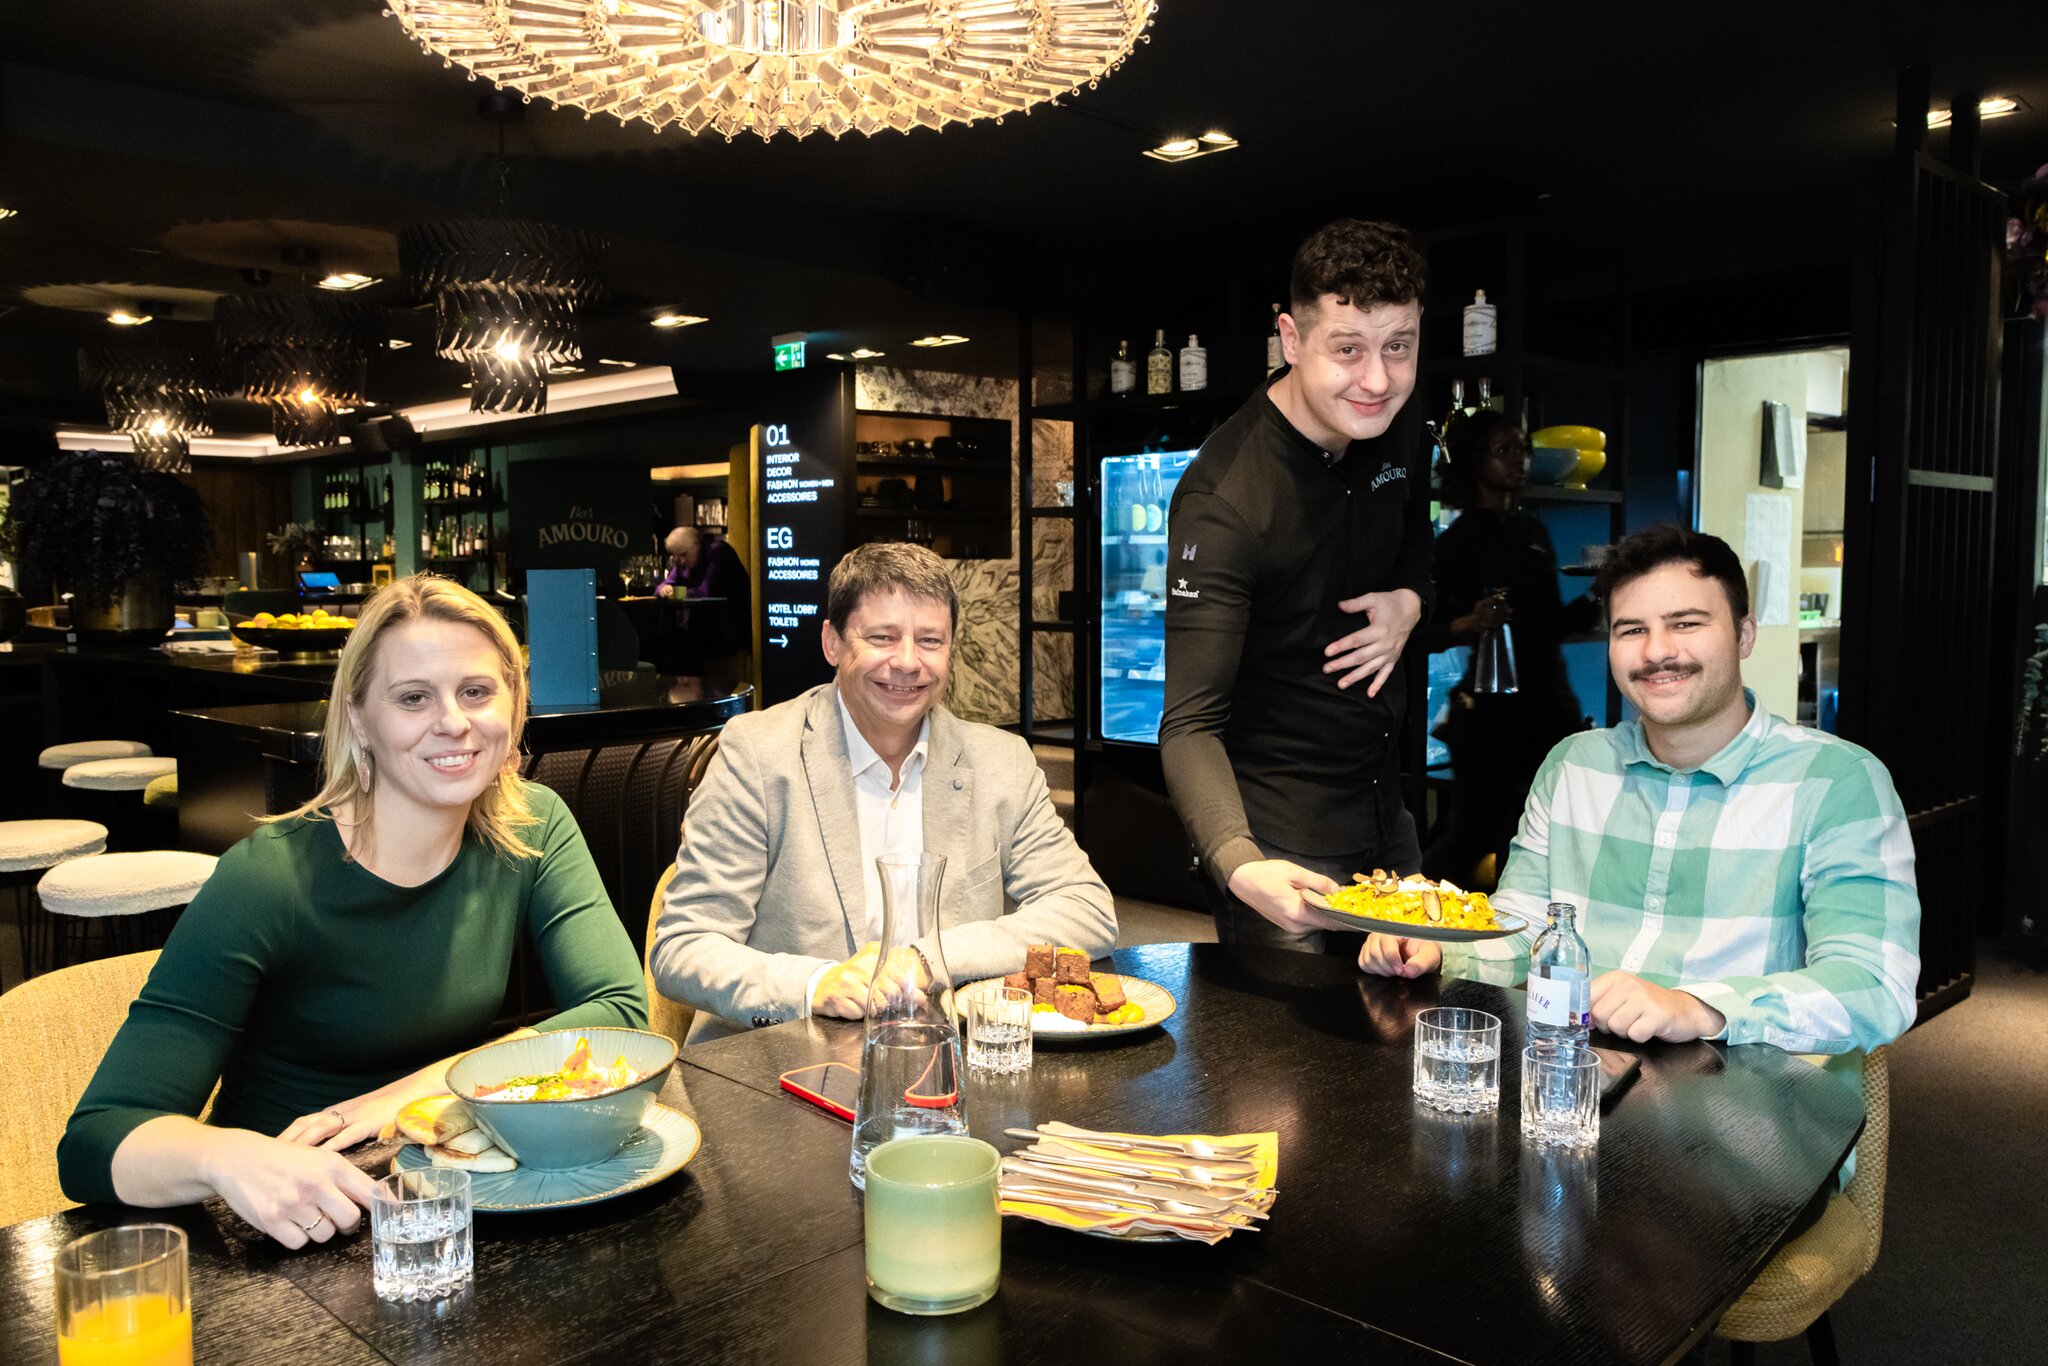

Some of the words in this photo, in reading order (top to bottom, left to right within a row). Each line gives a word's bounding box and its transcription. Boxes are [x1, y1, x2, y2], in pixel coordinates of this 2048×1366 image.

[766, 424, 790, 446] 01
[766, 452, 800, 464] INTERIOR
[766, 466, 792, 478] DECOR
[766, 479, 799, 490] FASHION
[1370, 467, 1407, 492] AMOURO
[767, 491, 818, 504] ACCESSOIRES
[538, 521, 629, 549] AMOURO
[767, 527, 793, 549] EG
[767, 557, 799, 567] FASHION
[800, 559, 820, 567] WOMEN
[768, 570, 819, 580] ACCESSOIRES
[768, 604, 792, 614] HOTEL
[793, 604, 817, 614] LOBBY
[769, 616, 798, 627] TOILETS
